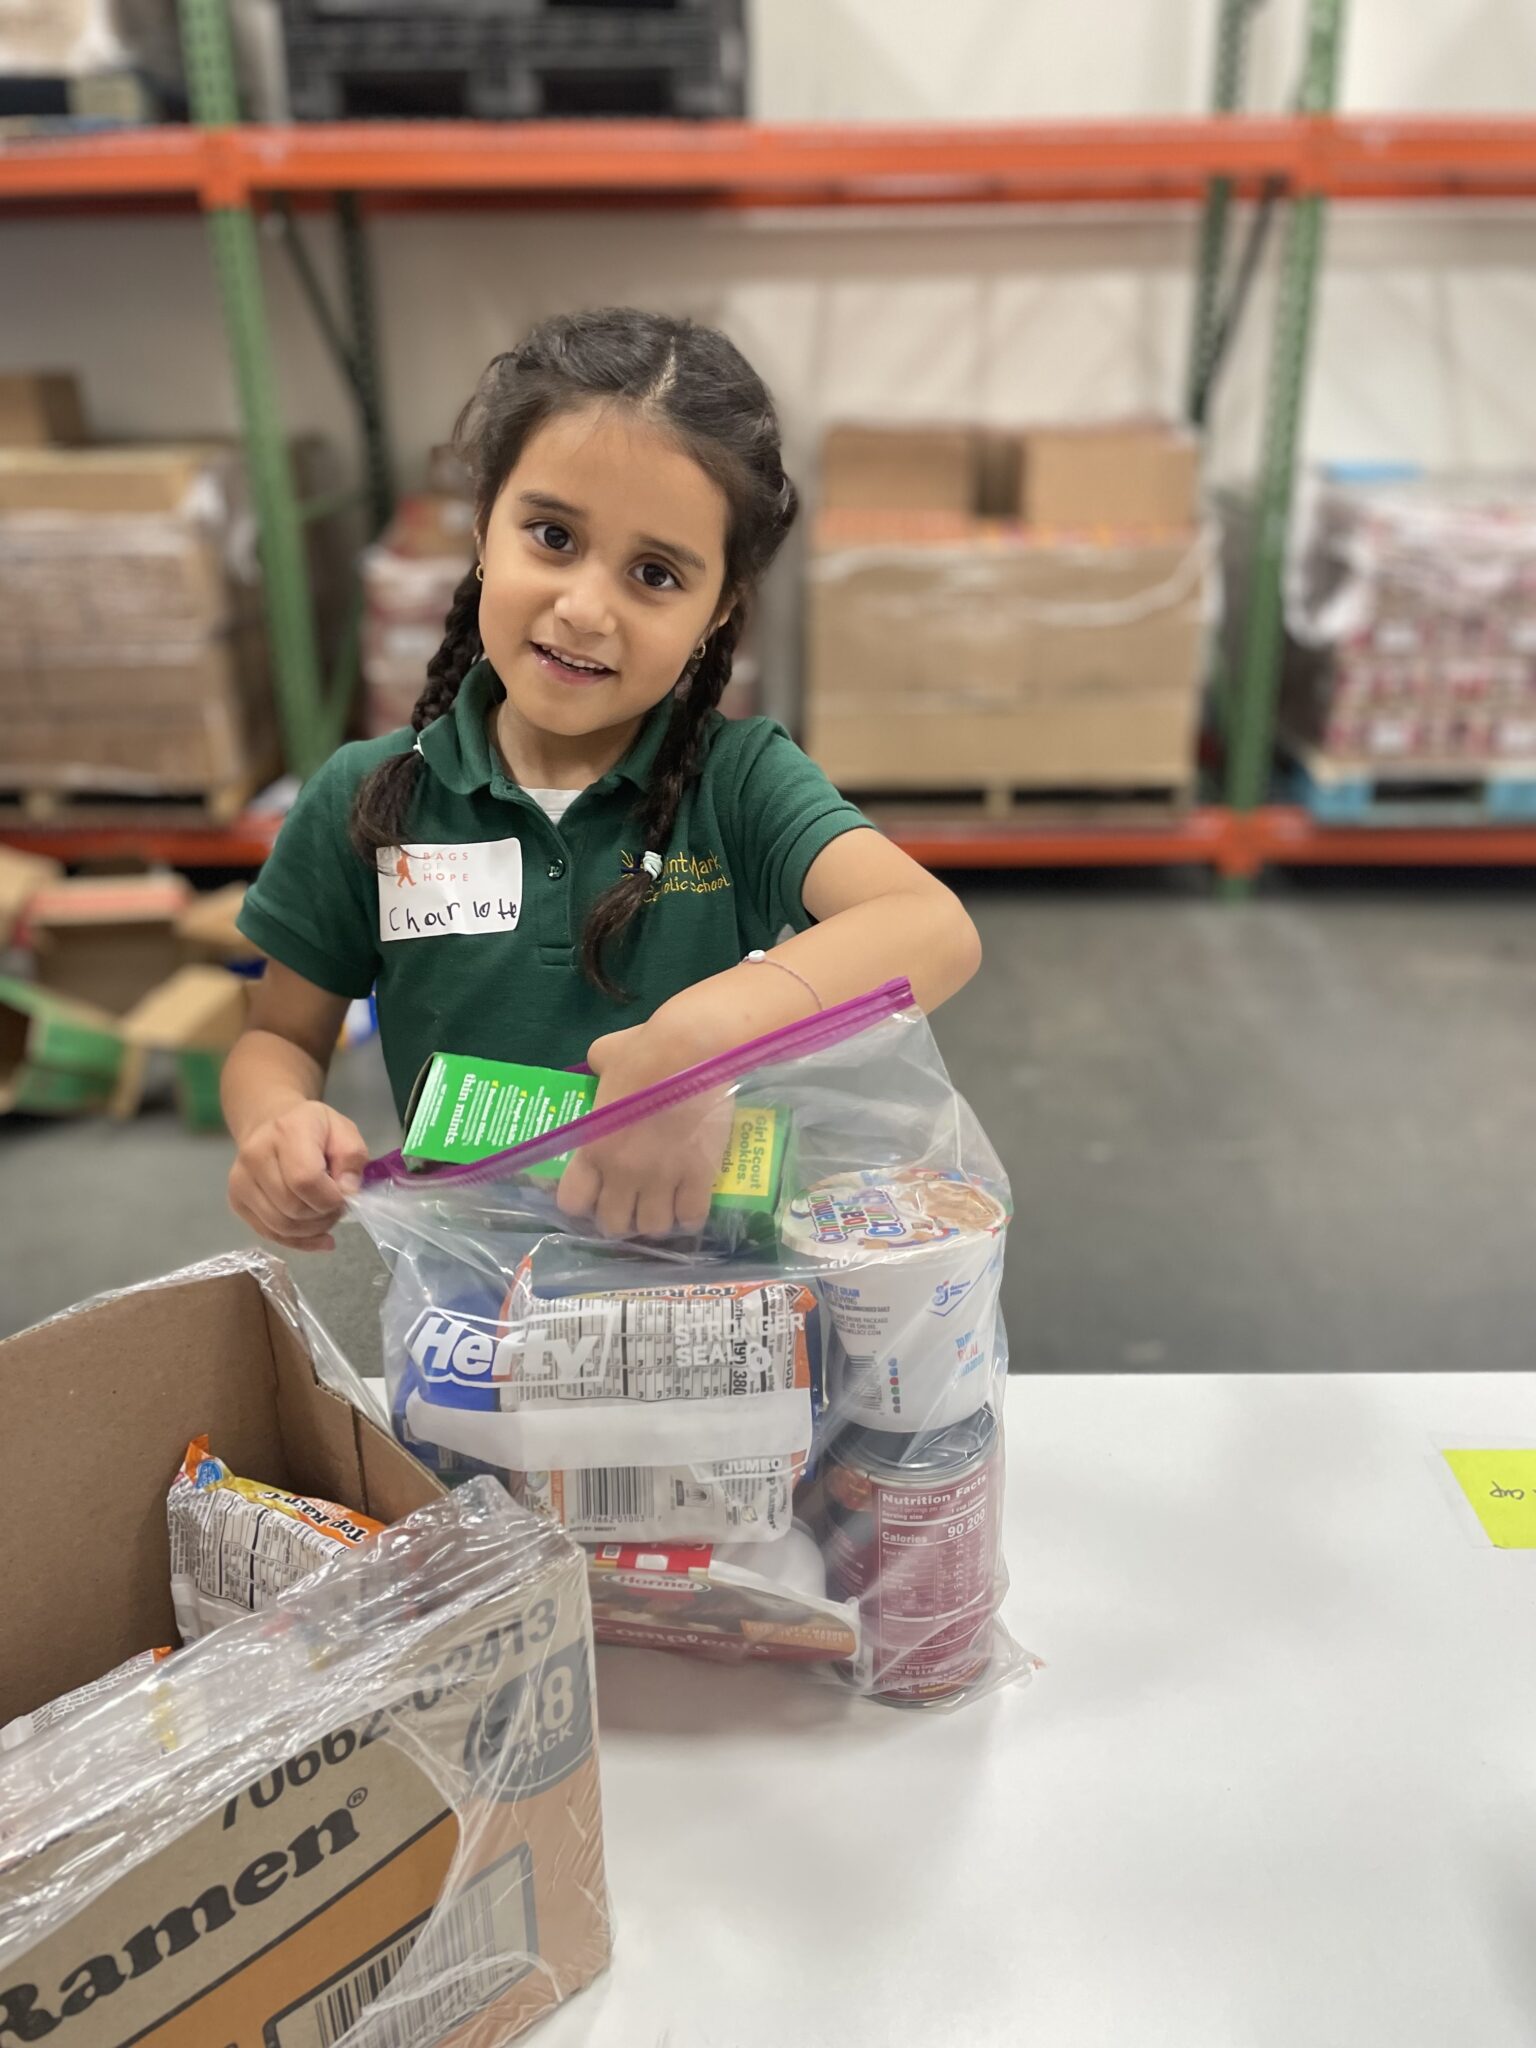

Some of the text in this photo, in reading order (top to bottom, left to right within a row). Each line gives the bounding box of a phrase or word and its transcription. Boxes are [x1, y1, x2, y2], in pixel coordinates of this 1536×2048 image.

[422, 851, 470, 861] BAGS
[422, 873, 470, 882] HOPE
[458, 1073, 477, 1102] thin
[750, 1116, 768, 1190] Girl Scout
[675, 1312, 805, 1346] STRONGER
[411, 1316, 599, 1380] Hefty
[675, 1341, 737, 1368] SEAL
[734, 1370, 748, 1396] 380
[724, 1458, 783, 1474] JUMBO
[881, 1493, 951, 1506] Nutrition
[955, 1475, 986, 1498] Facts
[328, 1519, 367, 1542] Top
[881, 1508, 985, 1544] Calories 90 200
[512, 1720, 574, 1773] PACK
